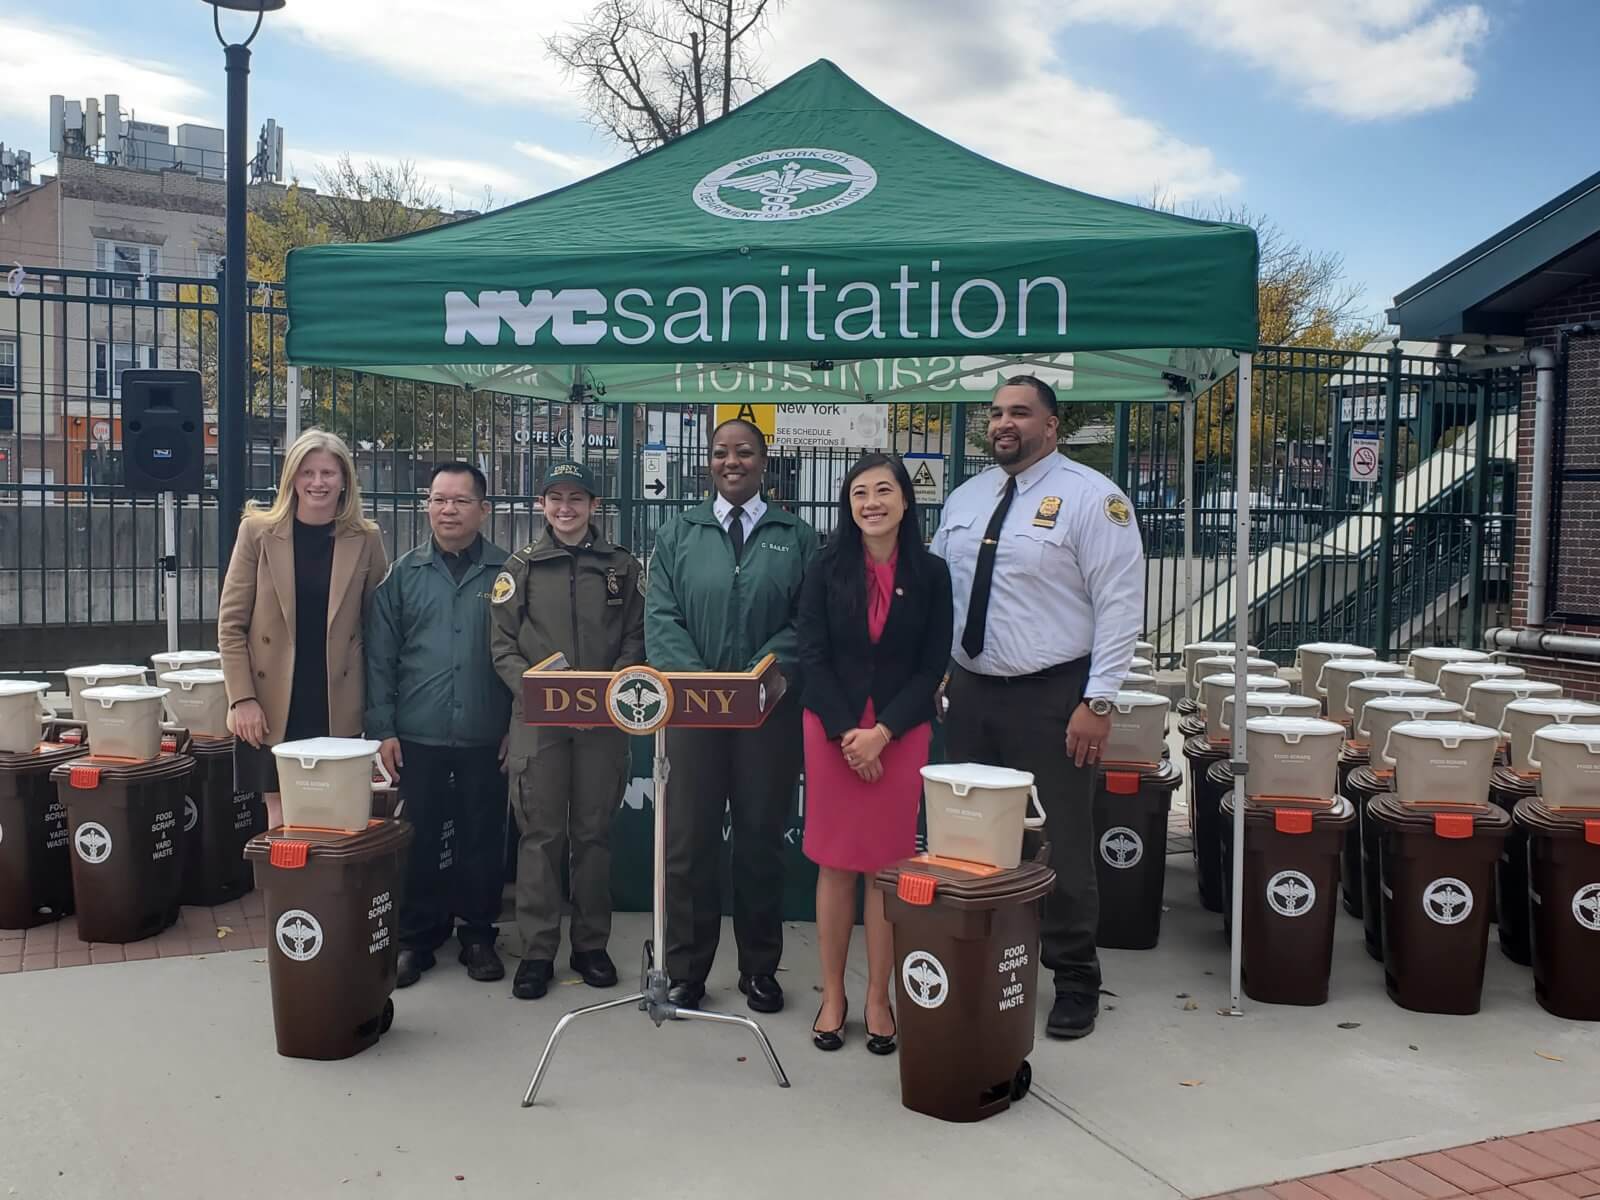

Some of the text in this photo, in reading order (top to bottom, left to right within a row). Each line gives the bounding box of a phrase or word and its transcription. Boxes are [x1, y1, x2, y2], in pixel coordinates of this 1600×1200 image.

[737, 150, 852, 168] NEW YORK CITY
[700, 192, 759, 219] DEPARTMENT
[788, 186, 865, 218] SANITATION
[444, 260, 1069, 347] NYC sanitation
[777, 403, 841, 416] New York
[776, 427, 832, 436] SEE SCHEDULE
[776, 437, 792, 445] FOR
[794, 437, 839, 446] EXCEPTIONS
[543, 687, 739, 714] DS NY
[45, 811, 67, 822] SCRA
[155, 811, 173, 822] FOOD
[152, 818, 176, 832] SCRAPS
[155, 839, 172, 851] YARD
[152, 846, 173, 861] WASTE
[372, 891, 390, 907] FOOD
[368, 900, 393, 920] SCRAPS
[372, 927, 389, 942] YARD
[368, 935, 390, 955] WASTE
[1004, 944, 1026, 960] FOOD
[998, 954, 1029, 973] SCRAPS
[1010, 971, 1017, 982] &
[1002, 982, 1023, 998] YARD
[998, 993, 1025, 1012] WASTE
